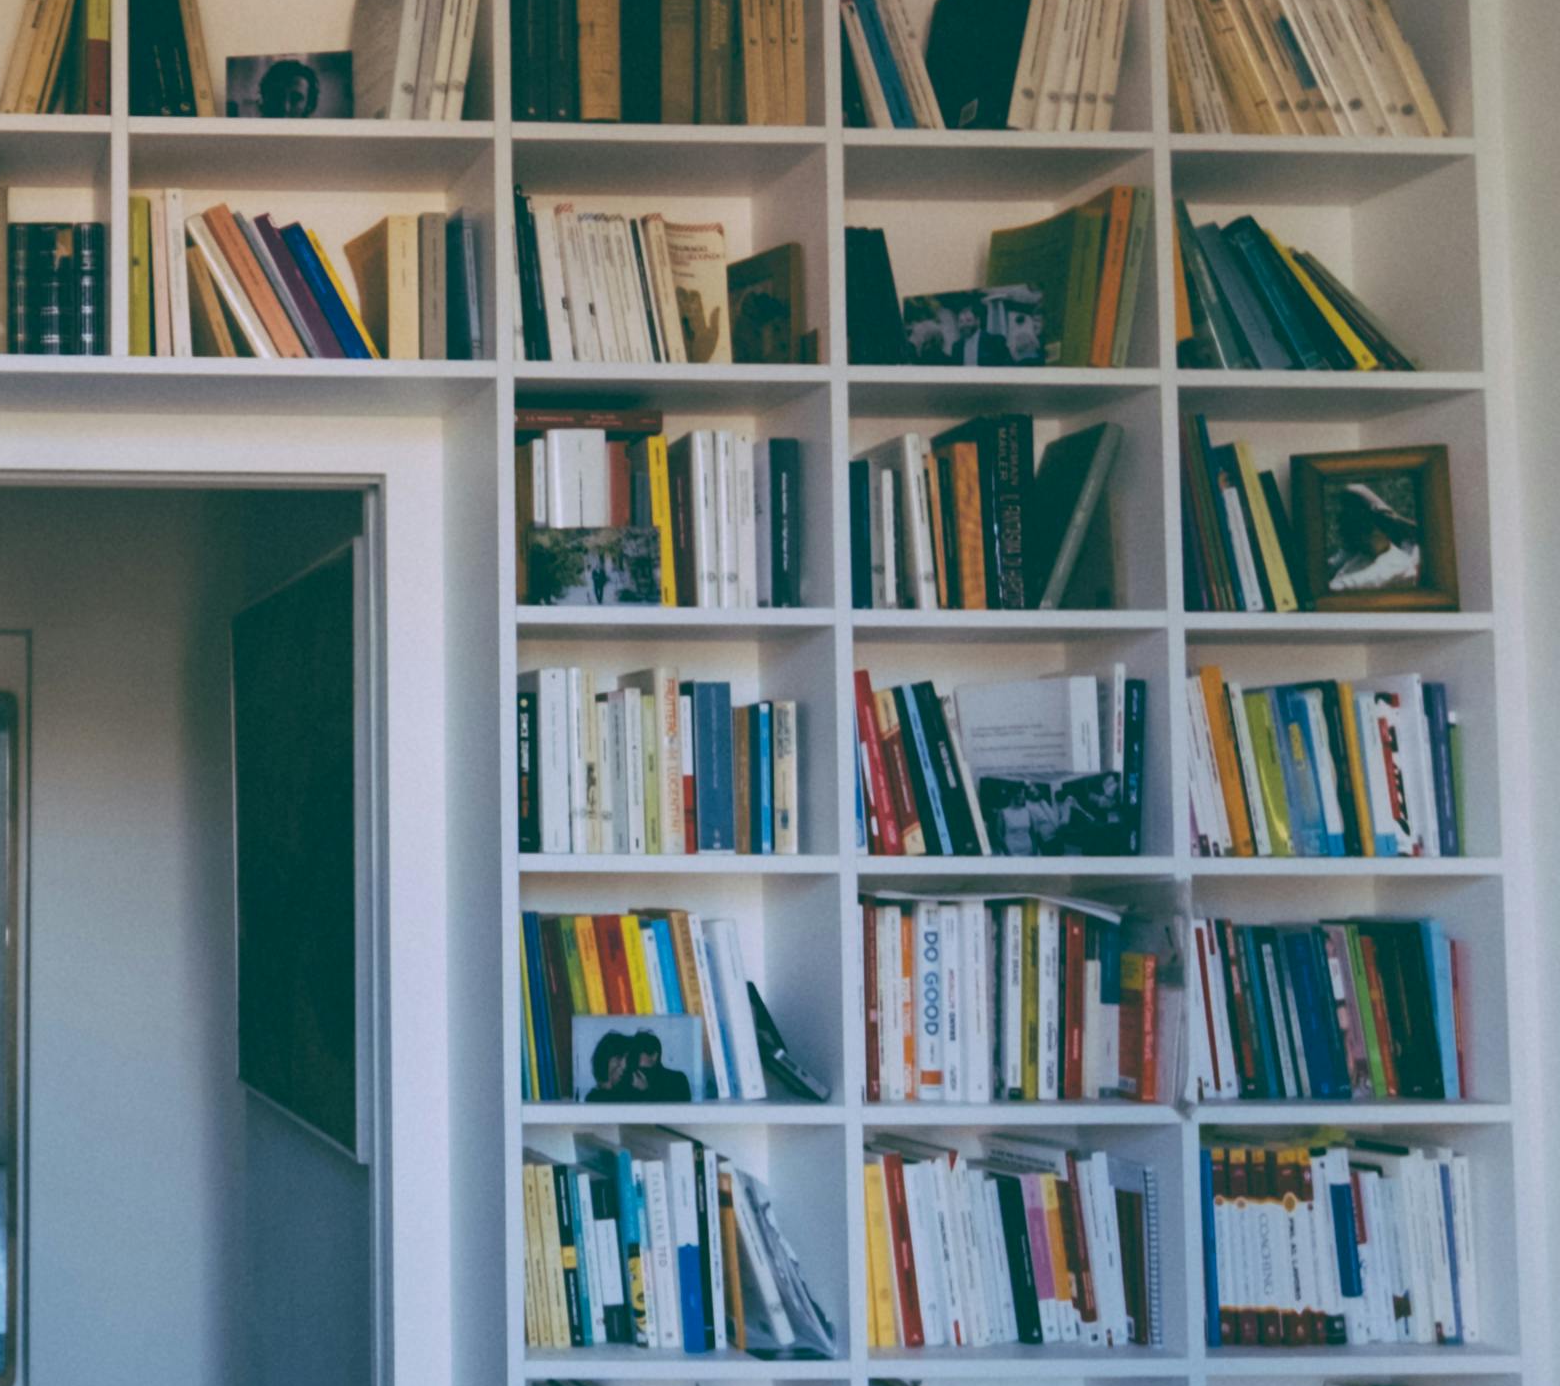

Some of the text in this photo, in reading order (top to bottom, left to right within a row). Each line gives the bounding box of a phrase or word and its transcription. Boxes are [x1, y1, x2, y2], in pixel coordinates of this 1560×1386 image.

[998, 426, 1009, 481] MAILER
[1009, 421, 1021, 486] NORMAN
[924, 930, 939, 1036] DO GOOD
[1144, 1033, 1154, 1062] Work
[657, 1245, 669, 1269] TED
[1259, 1212, 1273, 1295] COACHING
[1292, 1260, 1302, 1301] LAVORO
